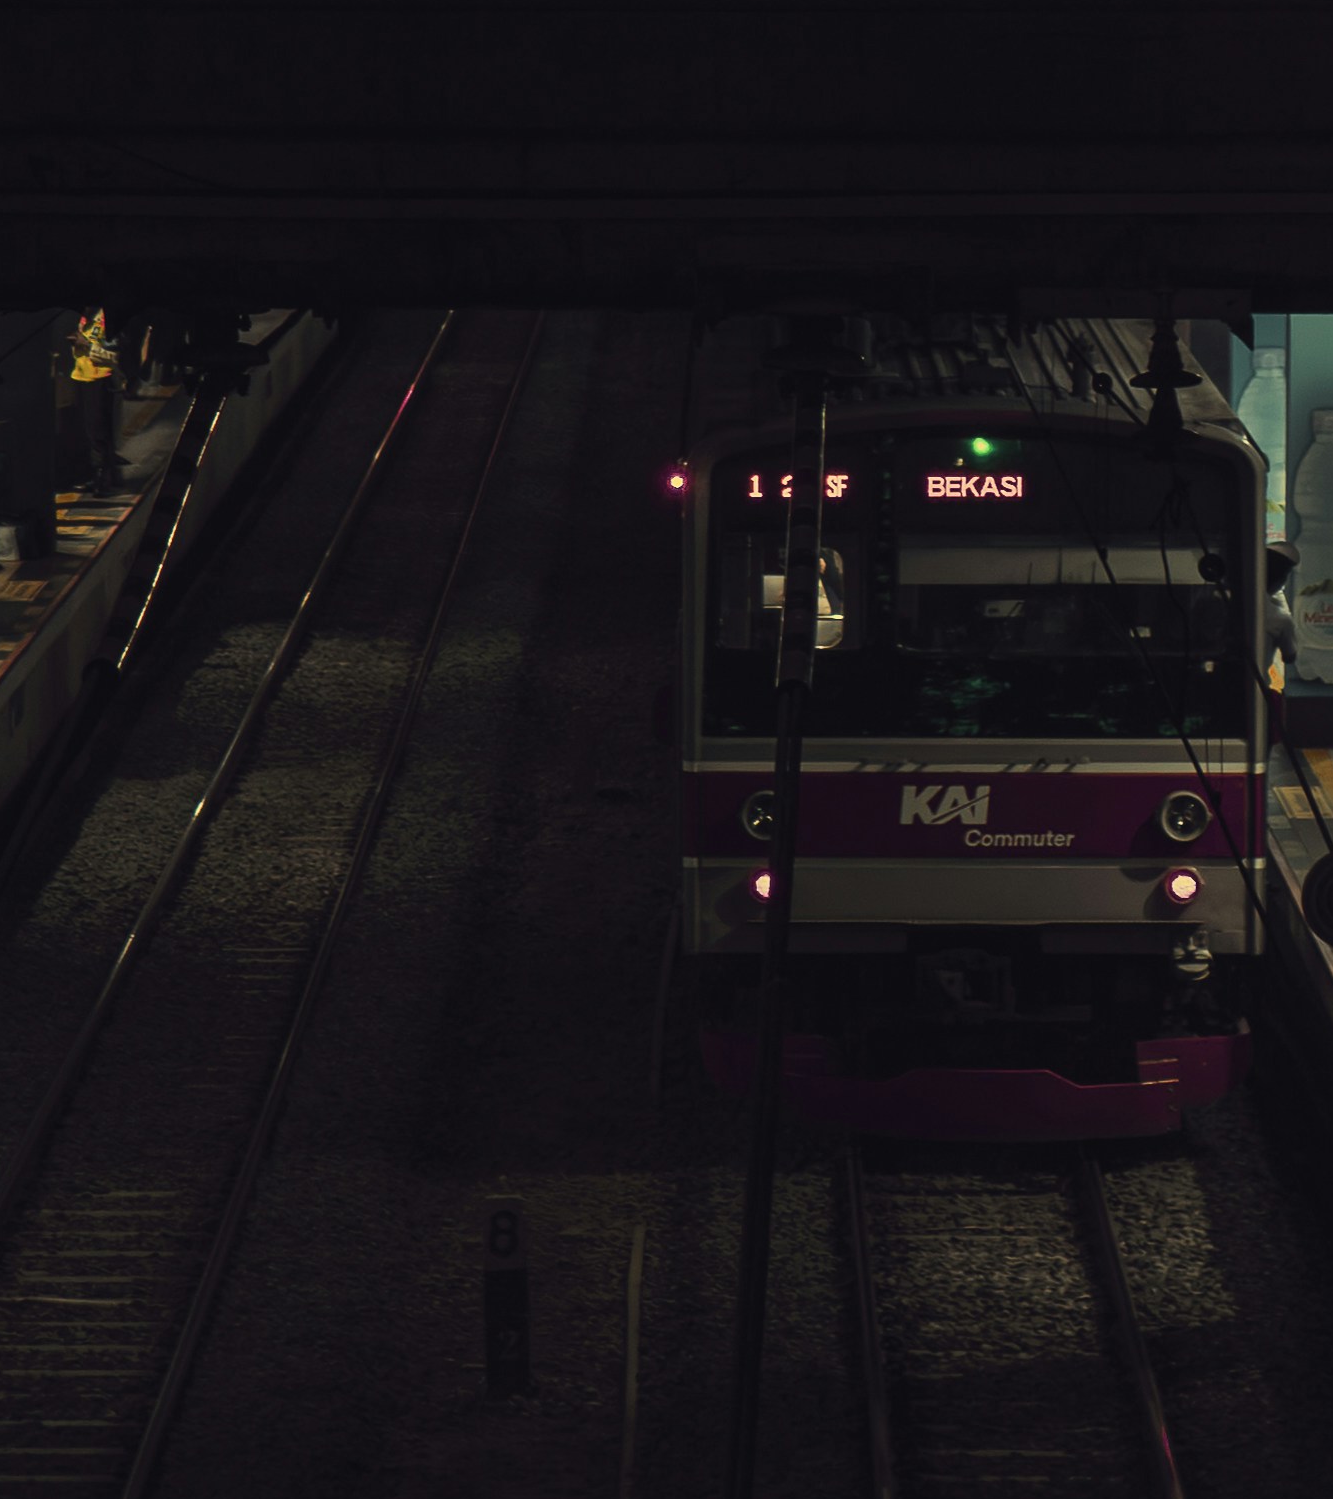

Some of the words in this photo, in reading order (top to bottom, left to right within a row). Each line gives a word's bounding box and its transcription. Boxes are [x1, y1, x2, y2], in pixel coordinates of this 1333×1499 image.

[927, 476, 1023, 498] BEKASI
[899, 785, 991, 825] KAI
[964, 829, 1076, 848] Commuter
